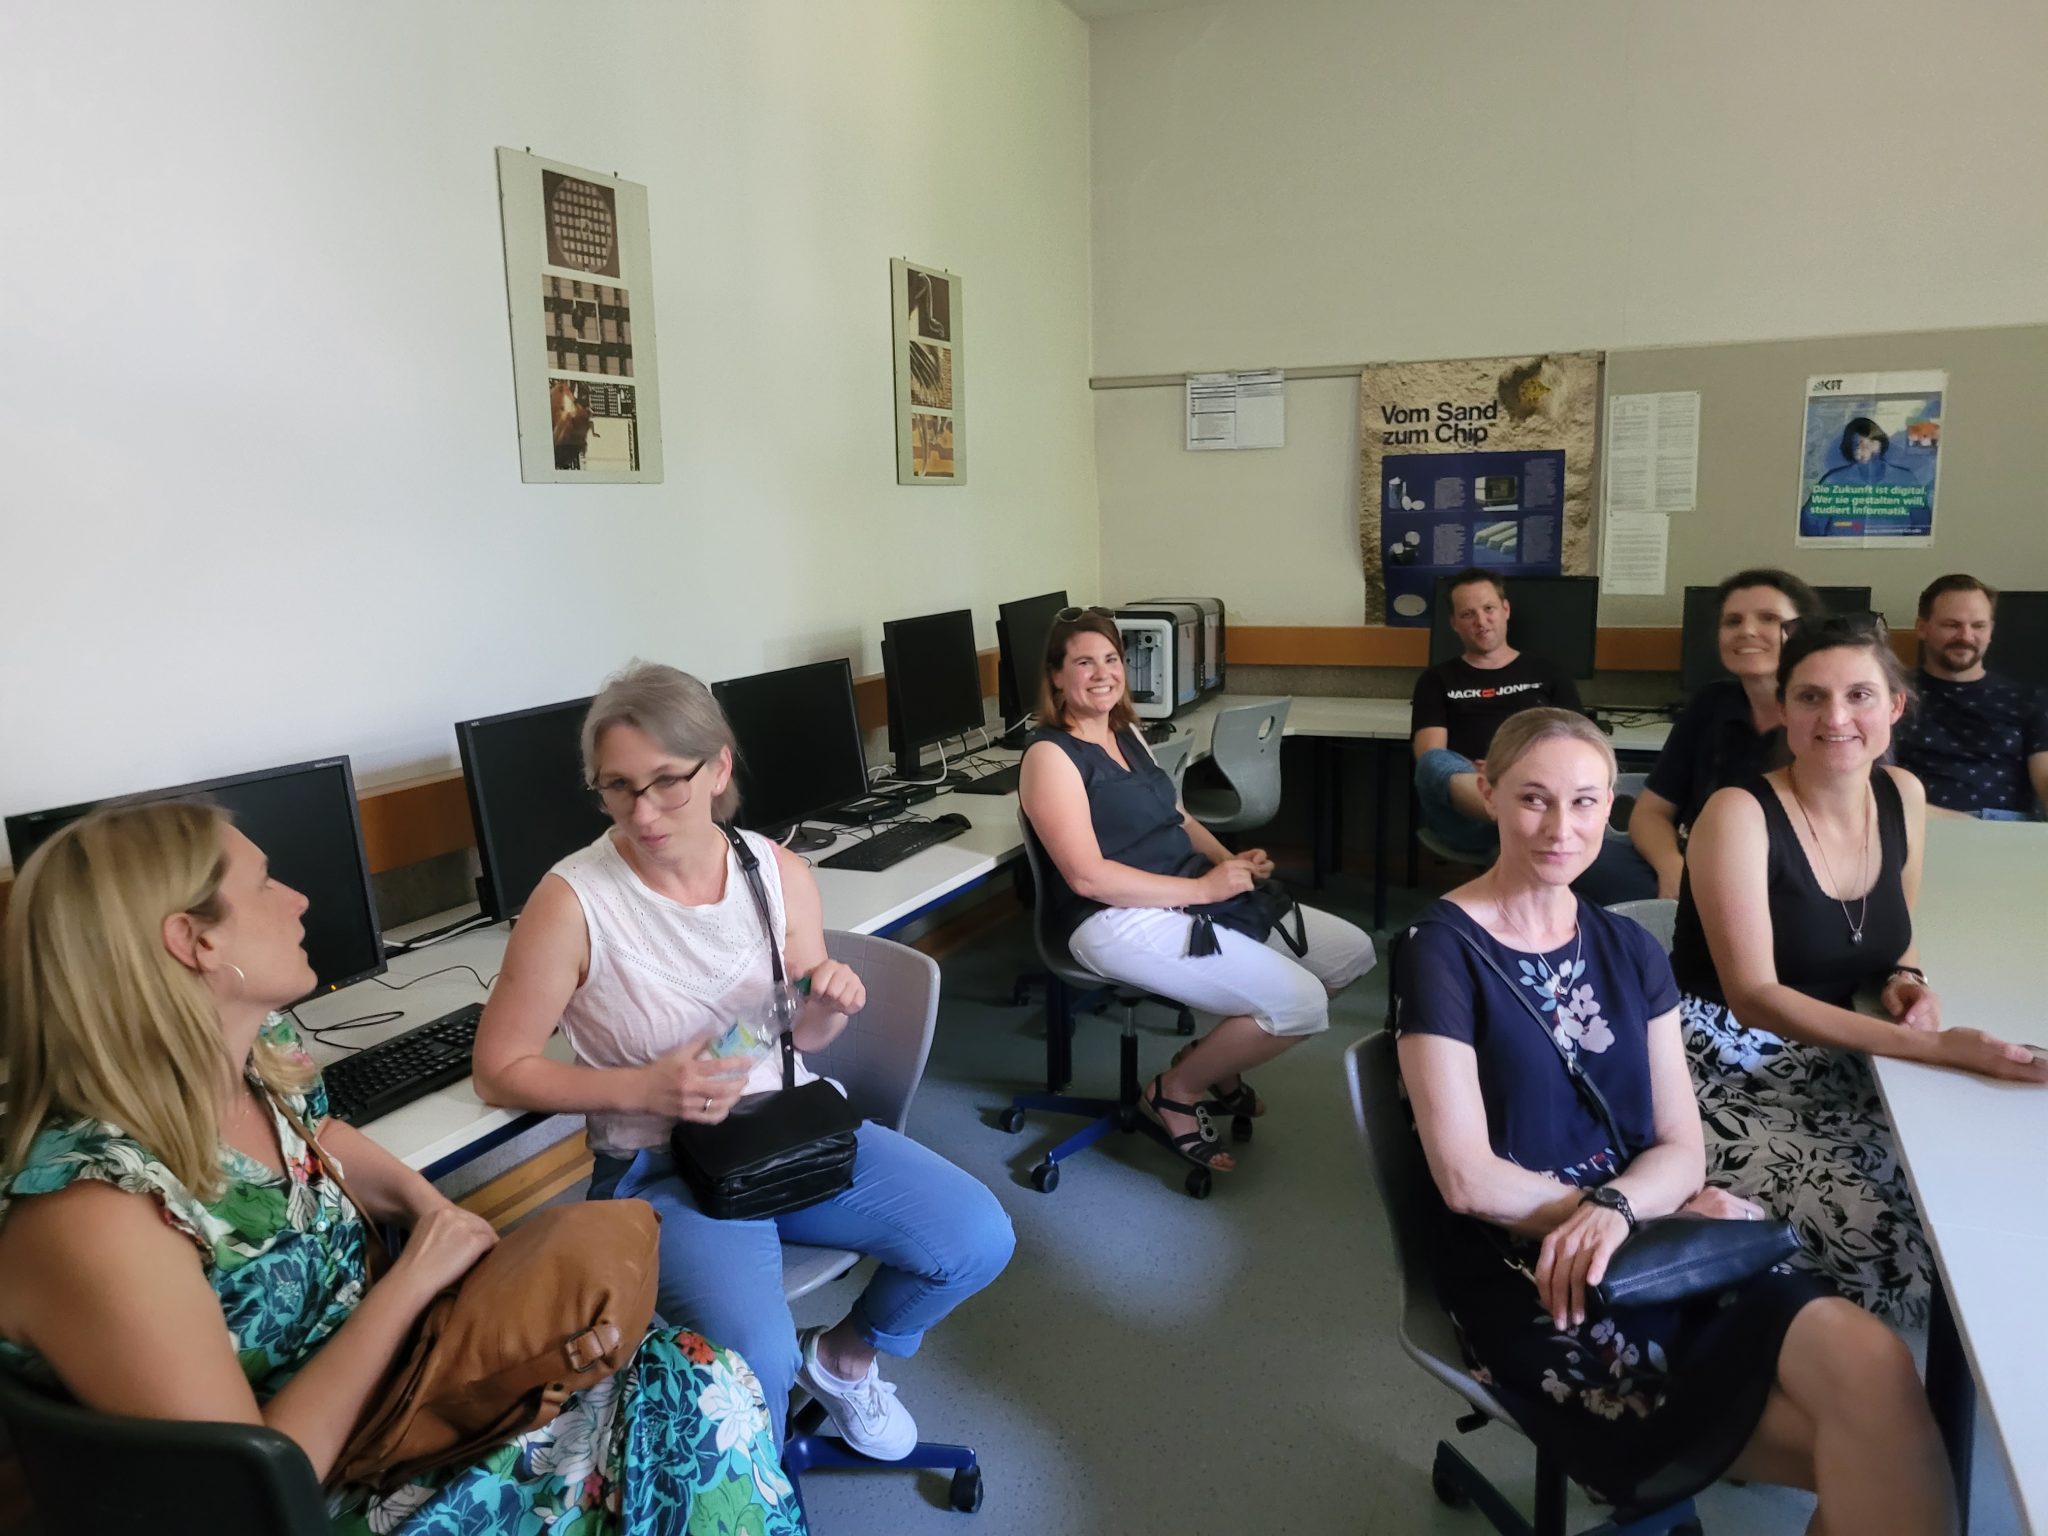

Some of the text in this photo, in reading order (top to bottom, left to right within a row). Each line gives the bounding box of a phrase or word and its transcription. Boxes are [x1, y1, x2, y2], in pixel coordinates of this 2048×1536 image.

[1823, 379, 1843, 391] KIT
[1381, 400, 1498, 425] Vom Sand
[1382, 422, 1489, 446] zum Chip
[1812, 485, 1926, 496] Die Zukunft ist digital.
[1811, 495, 1832, 503] Wer
[1835, 495, 1849, 504] sie
[1852, 495, 1900, 506] gestalten
[1810, 505, 1851, 515] studiert
[1447, 689, 1482, 699] JACK
